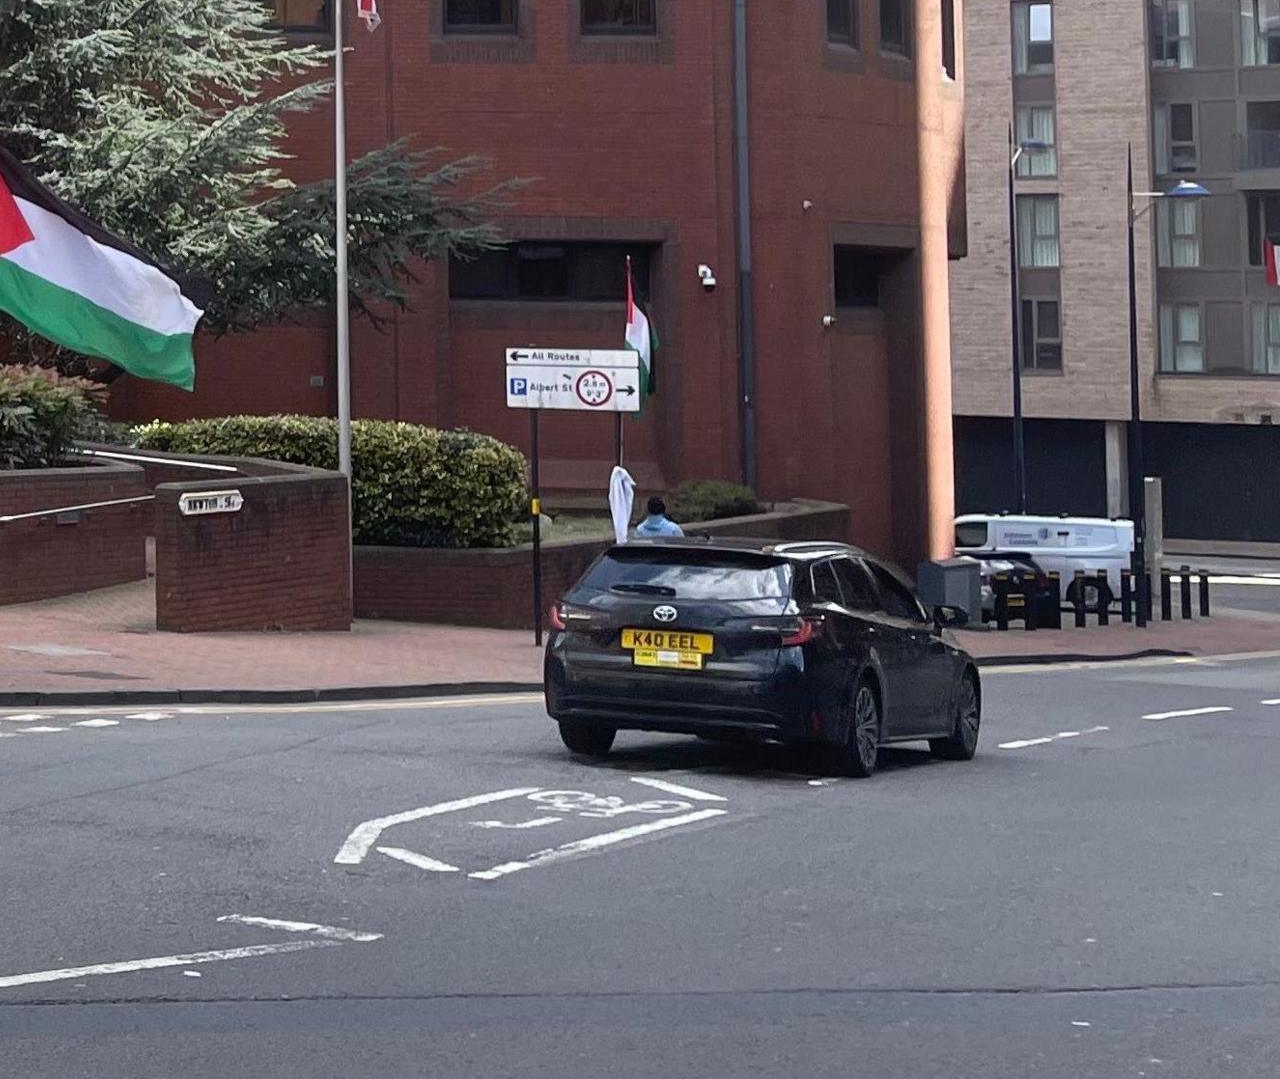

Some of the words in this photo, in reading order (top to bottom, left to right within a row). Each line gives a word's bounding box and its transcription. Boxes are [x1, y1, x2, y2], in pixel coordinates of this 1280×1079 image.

[532, 352, 544, 360] All
[547, 353, 580, 361] Routes
[530, 384, 558, 392] Albert
[633, 631, 664, 647] K40
[668, 634, 700, 650] EEL
